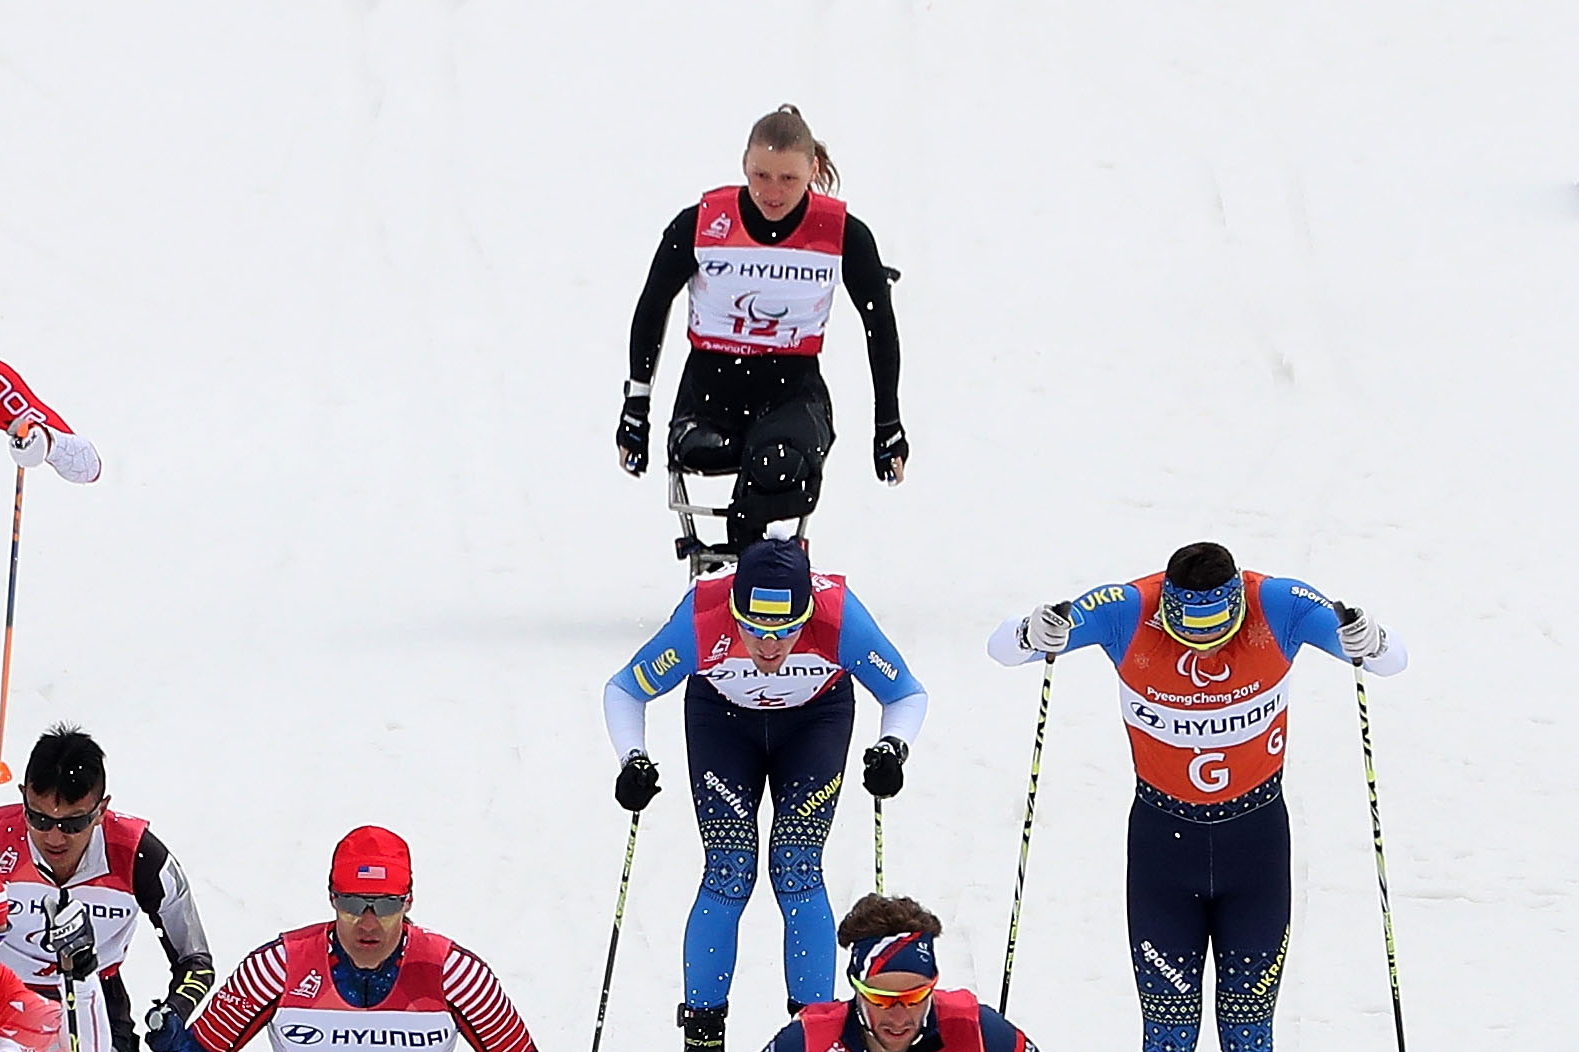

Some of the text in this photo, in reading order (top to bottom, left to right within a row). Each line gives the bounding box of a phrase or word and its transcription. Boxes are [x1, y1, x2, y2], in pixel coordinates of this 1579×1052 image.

[740, 263, 833, 282] HYUNDAI
[1080, 587, 1126, 611] UKR
[652, 648, 681, 676] UKR
[743, 665, 836, 679] HUNDA
[867, 651, 899, 681] sportful
[1146, 680, 1260, 706] PyeongChang 2018
[1174, 693, 1281, 736] HYUNDAI
[1267, 727, 1284, 755] G
[1187, 751, 1231, 794] G
[704, 770, 749, 819] sportful
[30, 900, 131, 919] HDAI
[1140, 940, 1191, 994] sportful
[332, 1028, 449, 1047] HYUNDAI
